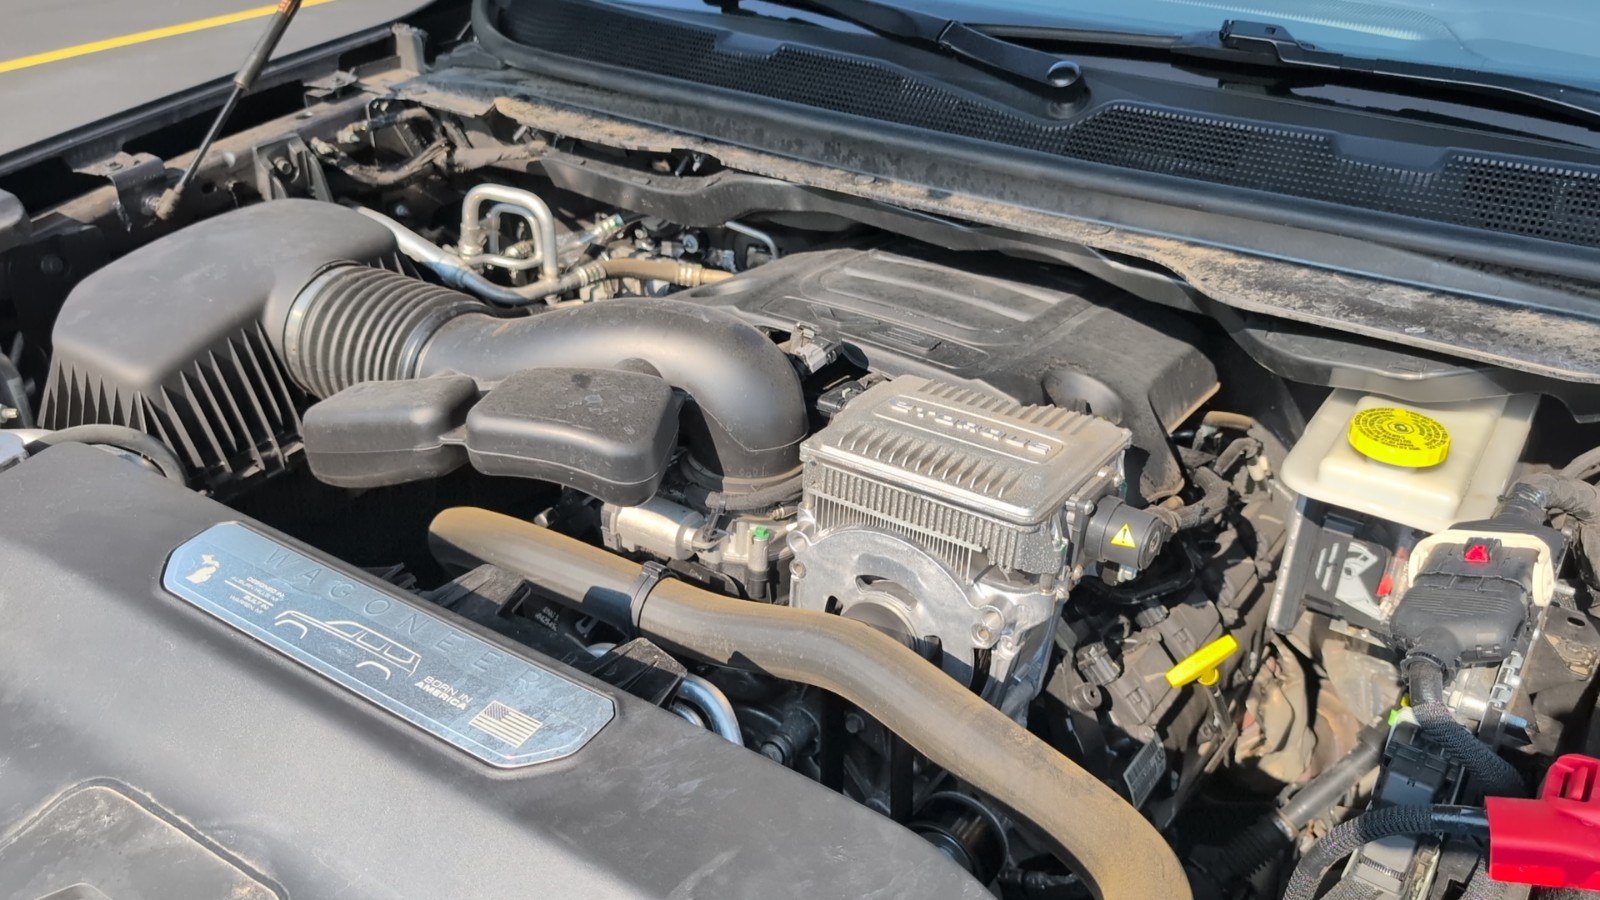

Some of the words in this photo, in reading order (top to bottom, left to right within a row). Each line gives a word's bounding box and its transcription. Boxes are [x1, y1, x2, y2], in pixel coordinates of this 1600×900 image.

[264, 548, 542, 692] WAGONEER
[414, 680, 468, 711] AMERICA
[423, 675, 459, 696] BORN
[458, 693, 474, 704] IN
